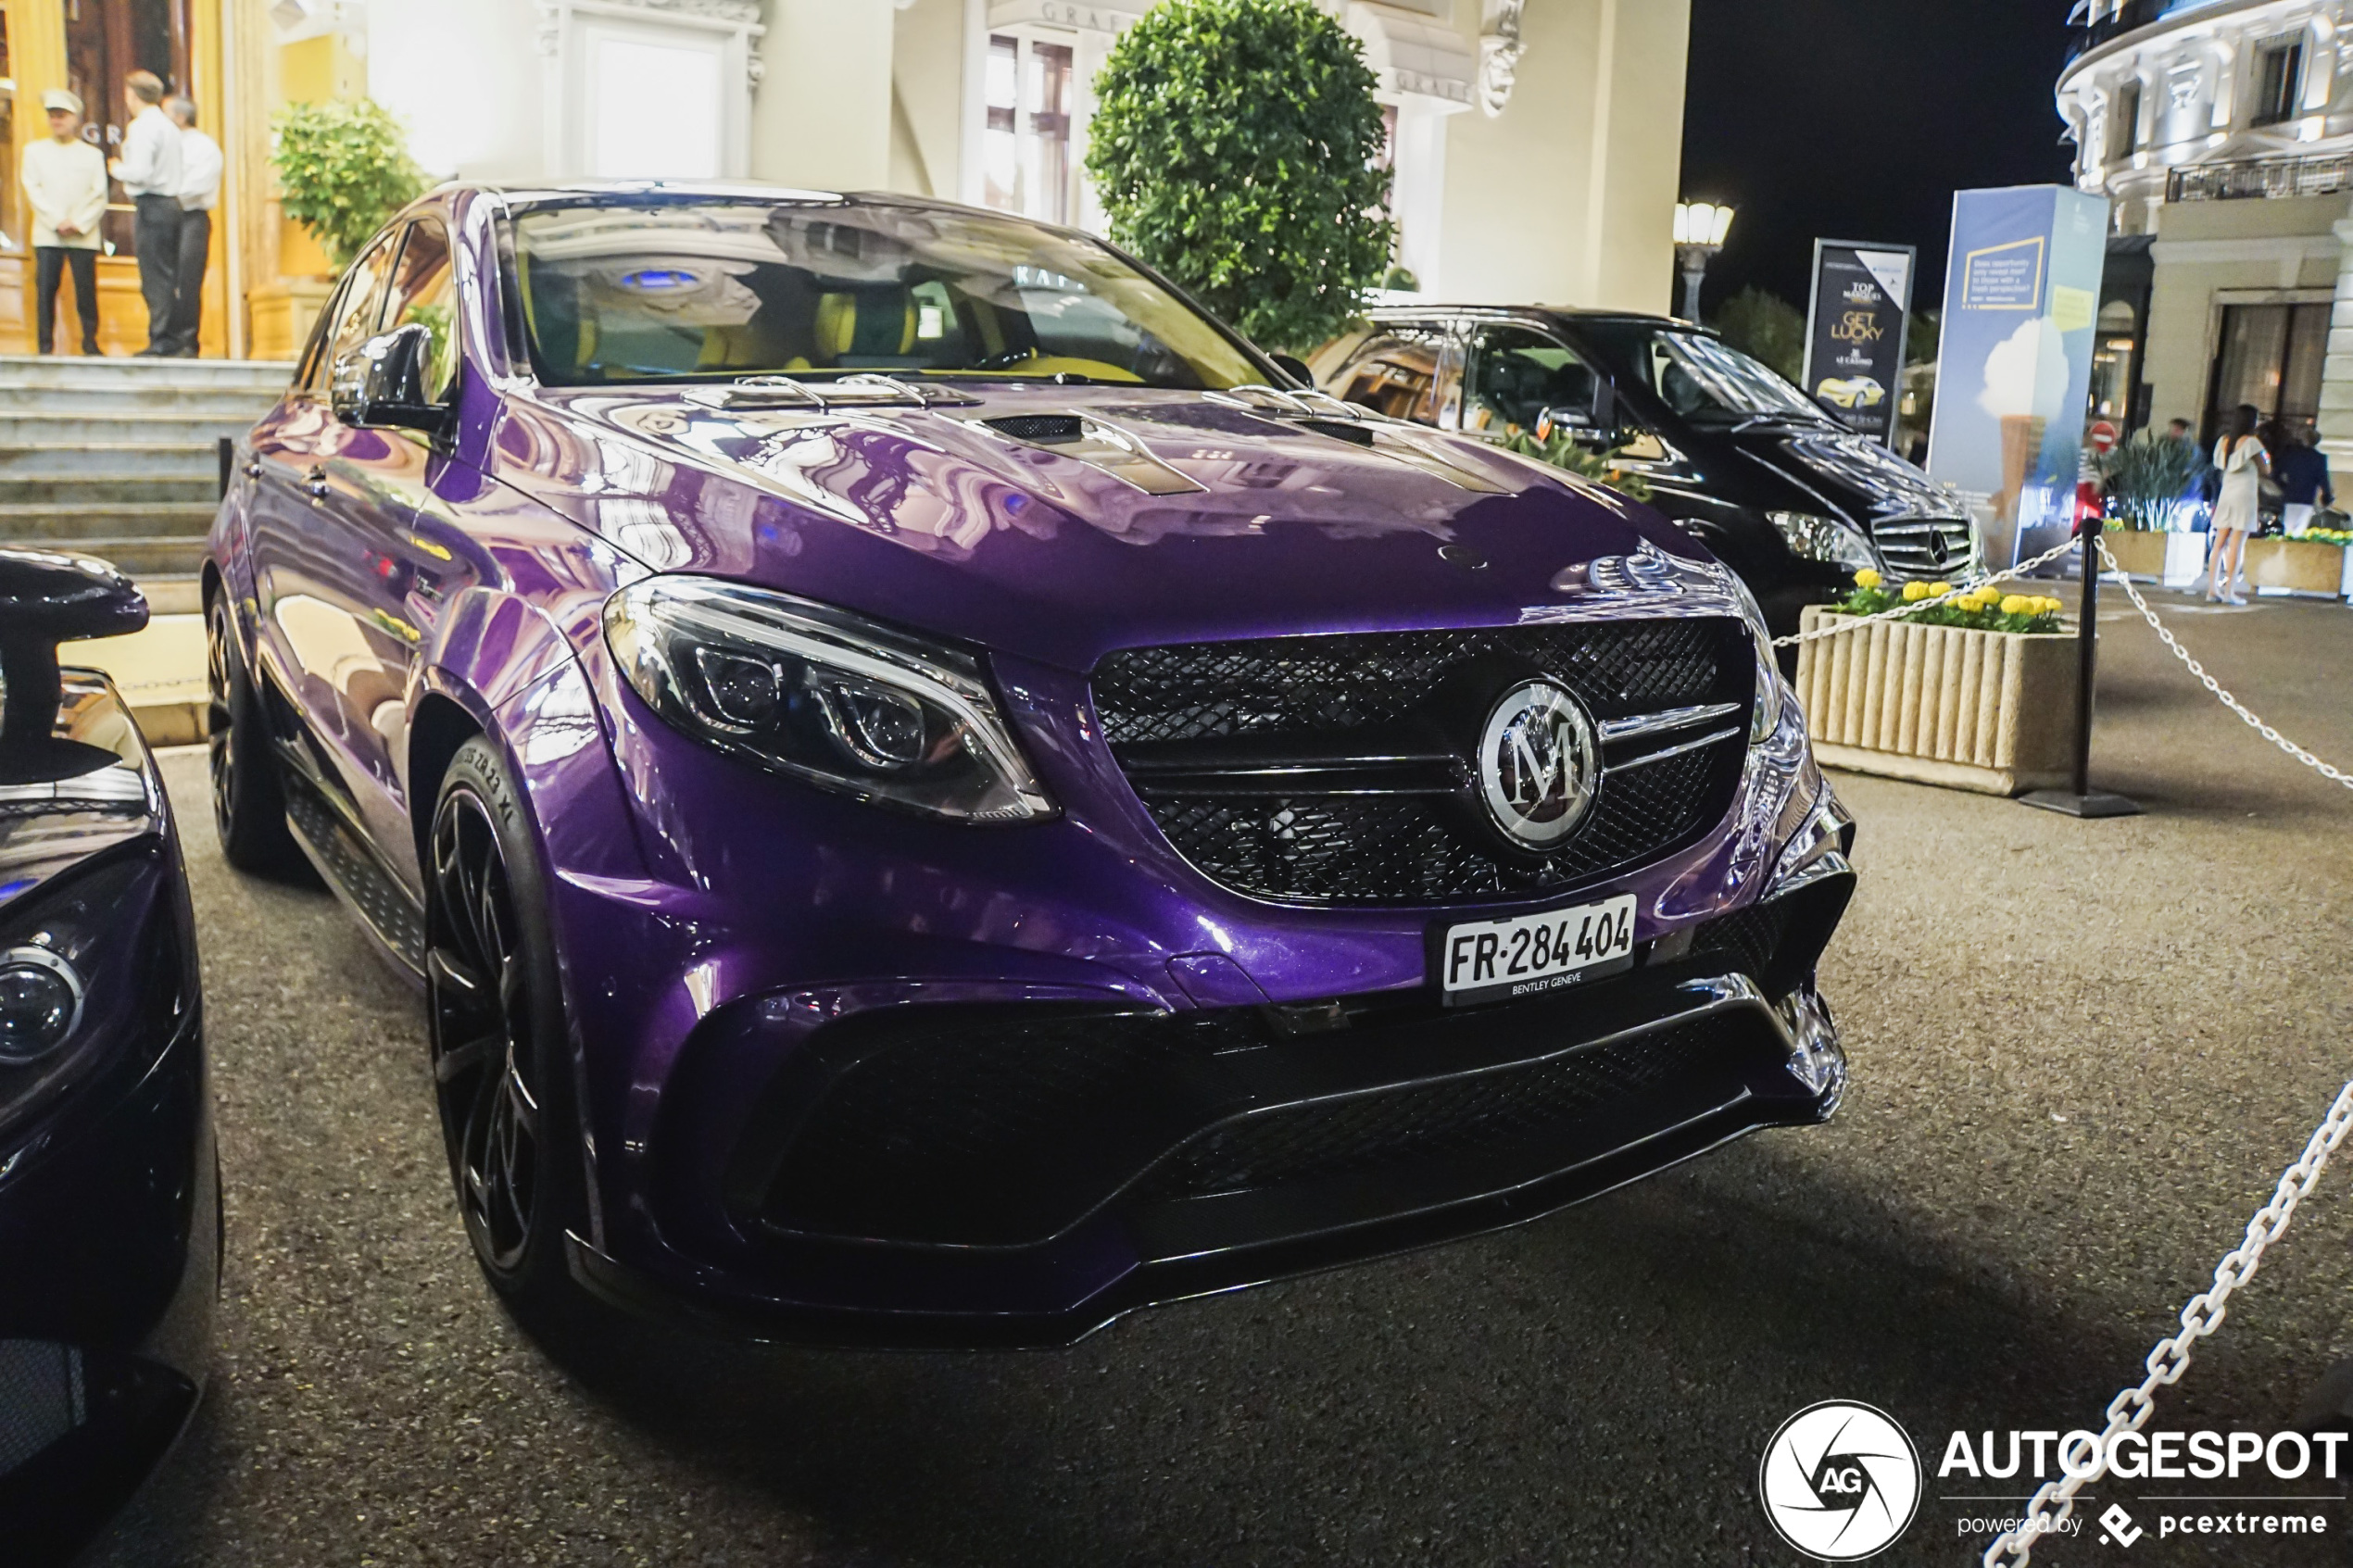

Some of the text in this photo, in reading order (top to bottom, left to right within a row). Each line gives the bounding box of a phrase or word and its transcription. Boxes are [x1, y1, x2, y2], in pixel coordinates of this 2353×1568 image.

[1041, 1, 1134, 34] GRAF
[1853, 282, 1874, 293] TOP
[1843, 310, 1875, 327] GET
[1831, 323, 1884, 341] LUCKY
[1512, 979, 1549, 996] BENTLEY
